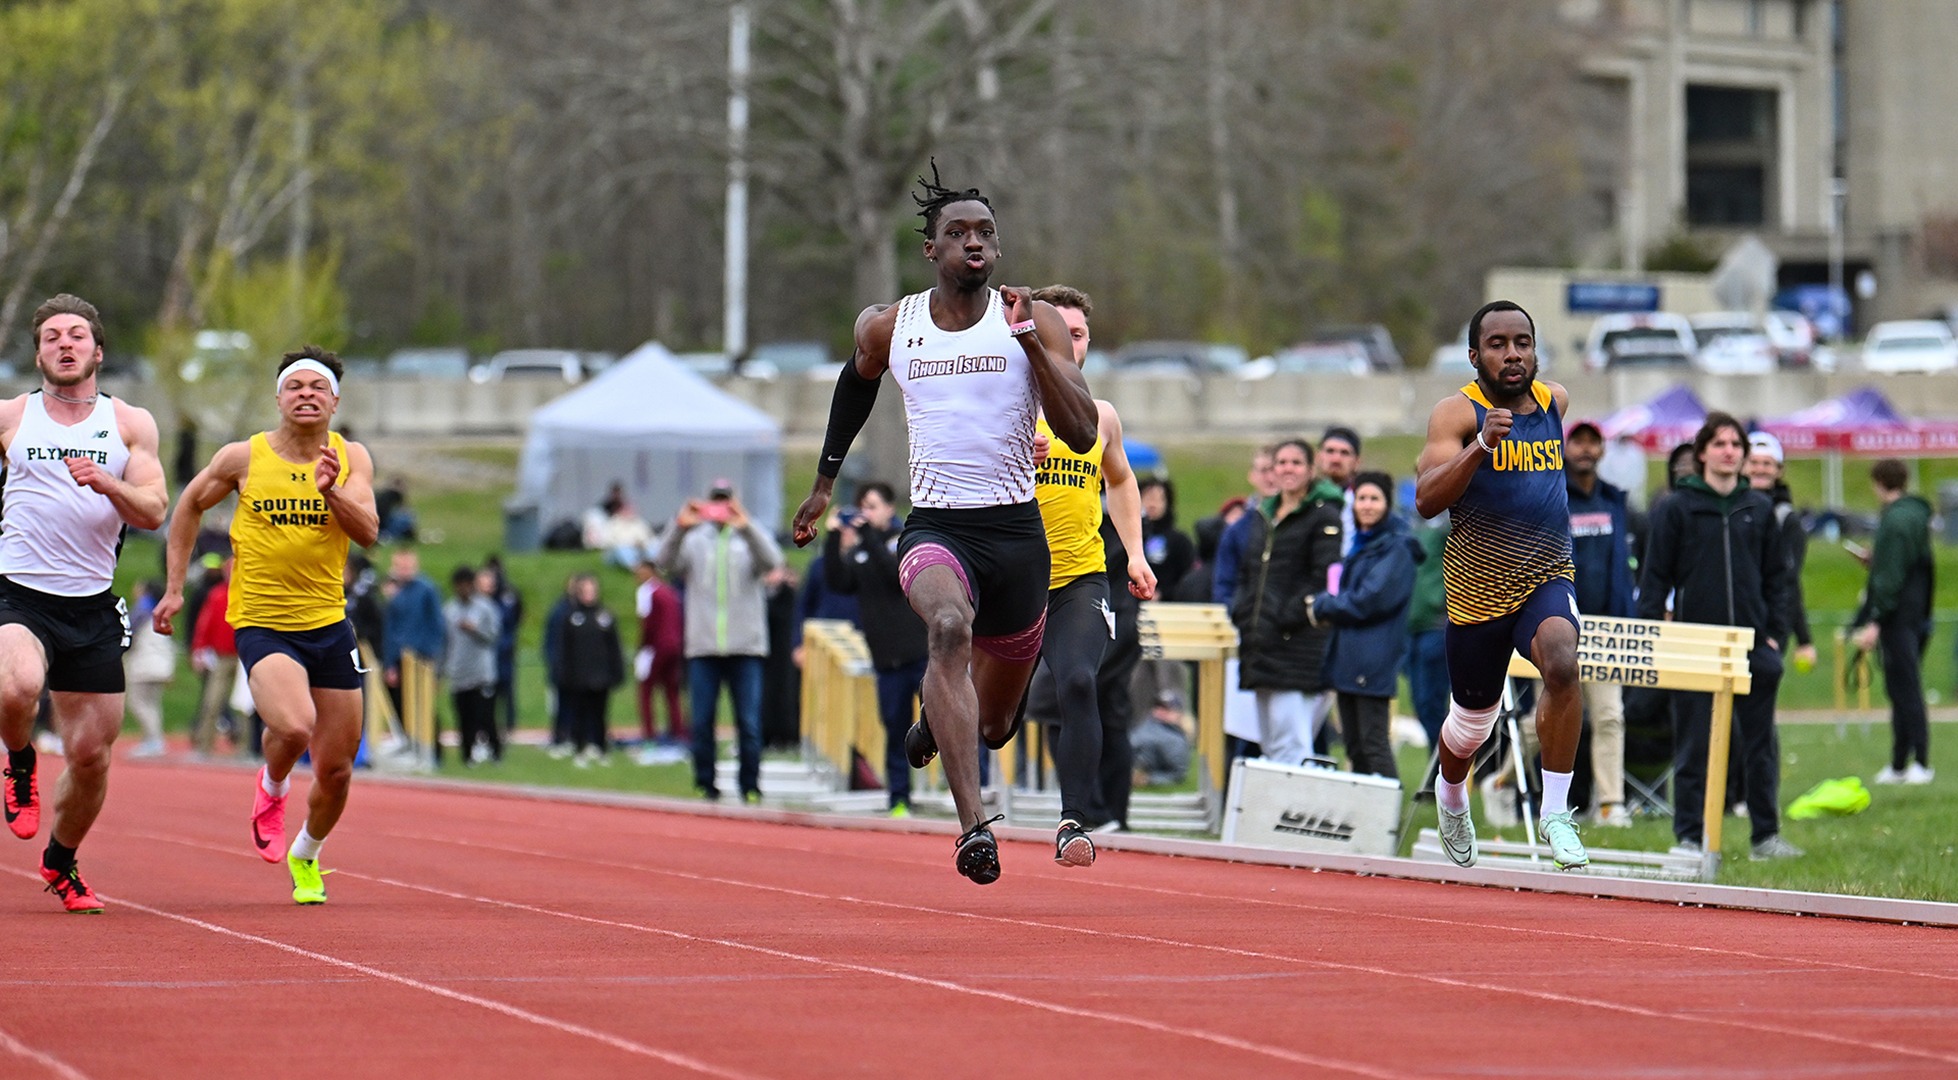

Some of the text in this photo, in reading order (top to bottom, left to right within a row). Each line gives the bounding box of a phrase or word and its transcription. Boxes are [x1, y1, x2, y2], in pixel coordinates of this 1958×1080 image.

[908, 355, 1007, 381] RHODE ISLAND
[27, 447, 108, 465] PLYMOUTH
[1035, 457, 1098, 478] UTHERN
[1035, 472, 1086, 489] MAINE
[252, 498, 329, 513] SOUTHE
[270, 513, 329, 526] MAINE
[1583, 620, 1661, 637] RSAIRS
[1578, 635, 1654, 653] RSAIRS
[1581, 664, 1659, 686] RSAIRS
